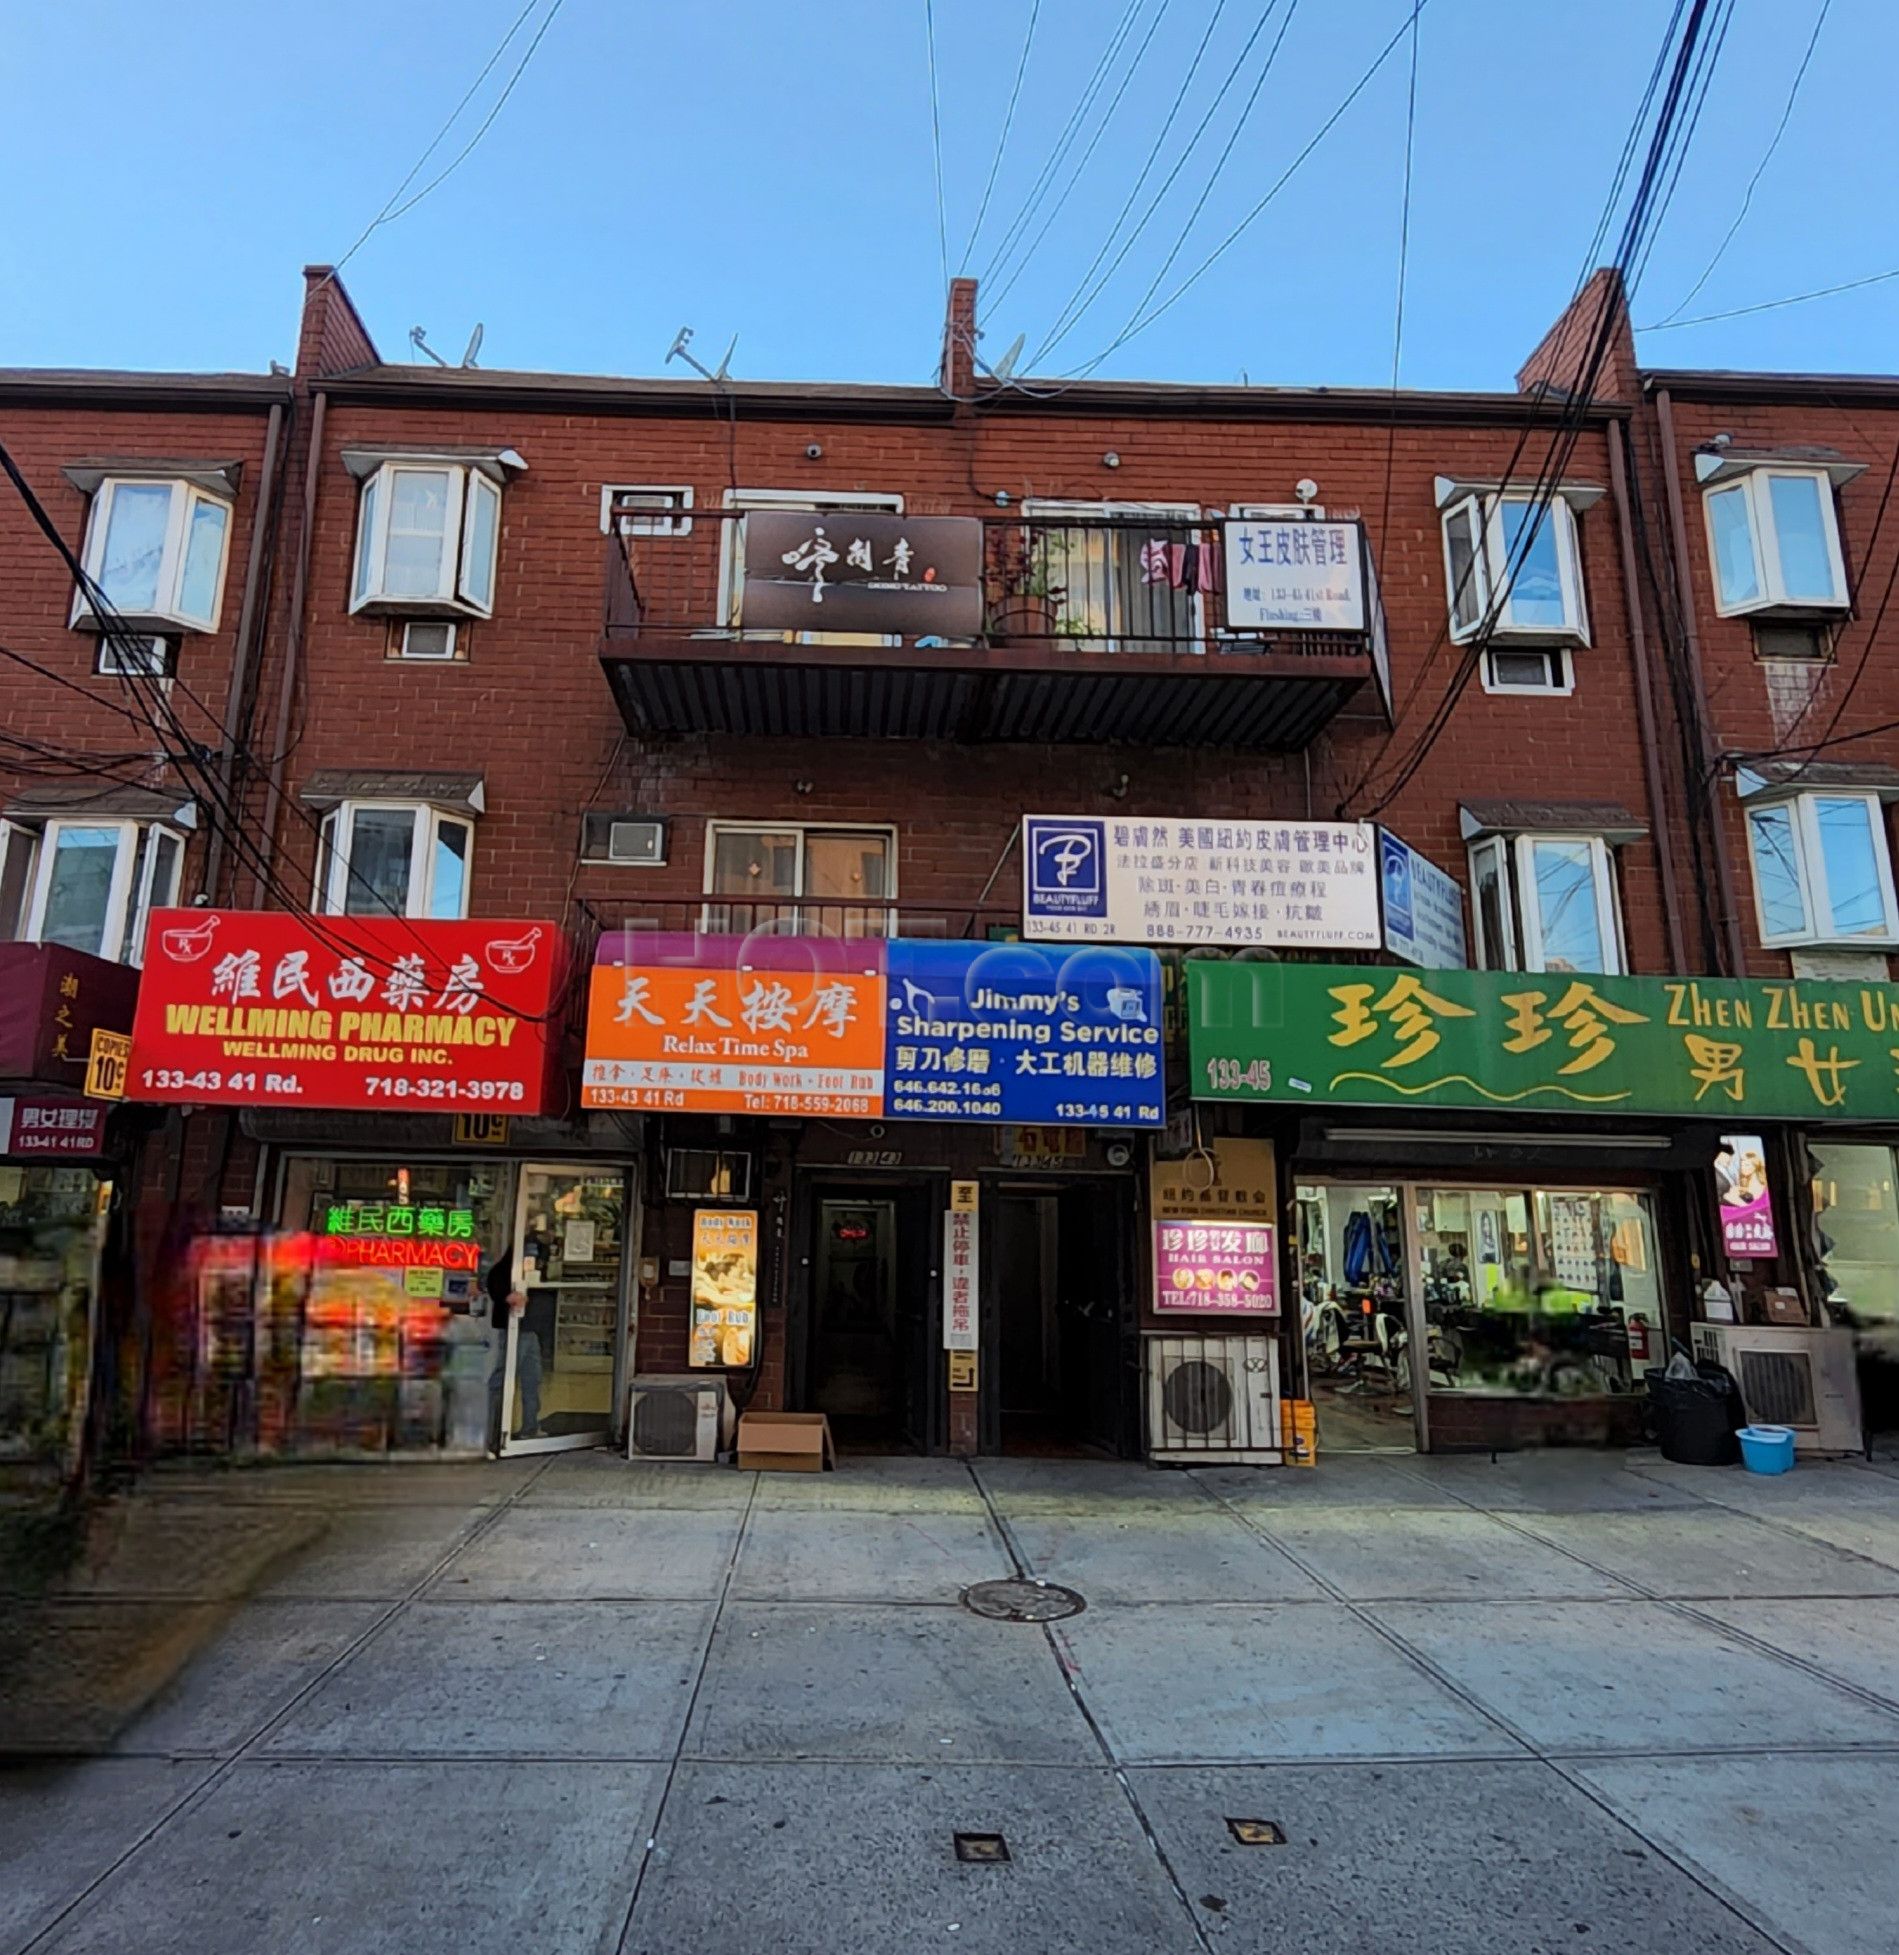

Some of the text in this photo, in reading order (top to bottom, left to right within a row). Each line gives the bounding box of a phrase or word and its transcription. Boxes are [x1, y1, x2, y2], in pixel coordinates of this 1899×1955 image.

[1239, 527, 1347, 566] 女王皮肤管理
[1147, 924, 1263, 940] 888-777-4935
[212, 949, 484, 1014] 維民西藥房
[612, 976, 859, 1040] 天天按摩
[970, 988, 1080, 1015] Jimmy's
[166, 1003, 517, 1047] WELLMING PHARMACY
[897, 1015, 1159, 1045] Sharpening Service
[223, 1041, 453, 1065] WELLMING DRUG INC.
[662, 1035, 808, 1062] Relax Time Spa
[142, 1069, 303, 1094] 133-43 41 Rd.
[1207, 1058, 1272, 1091] 133-45
[365, 1077, 524, 1101] 718-321-3978
[643, 1090, 660, 1106] 41
[663, 1090, 685, 1107] Rd
[744, 1093, 771, 1110] Tel:
[1056, 1103, 1160, 1120] 133-45 41 Rd
[327, 1204, 473, 1238] 維民西藥房
[346, 1238, 482, 1271] PHARMACY
[1168, 1254, 1265, 1266] HAIR SALON
